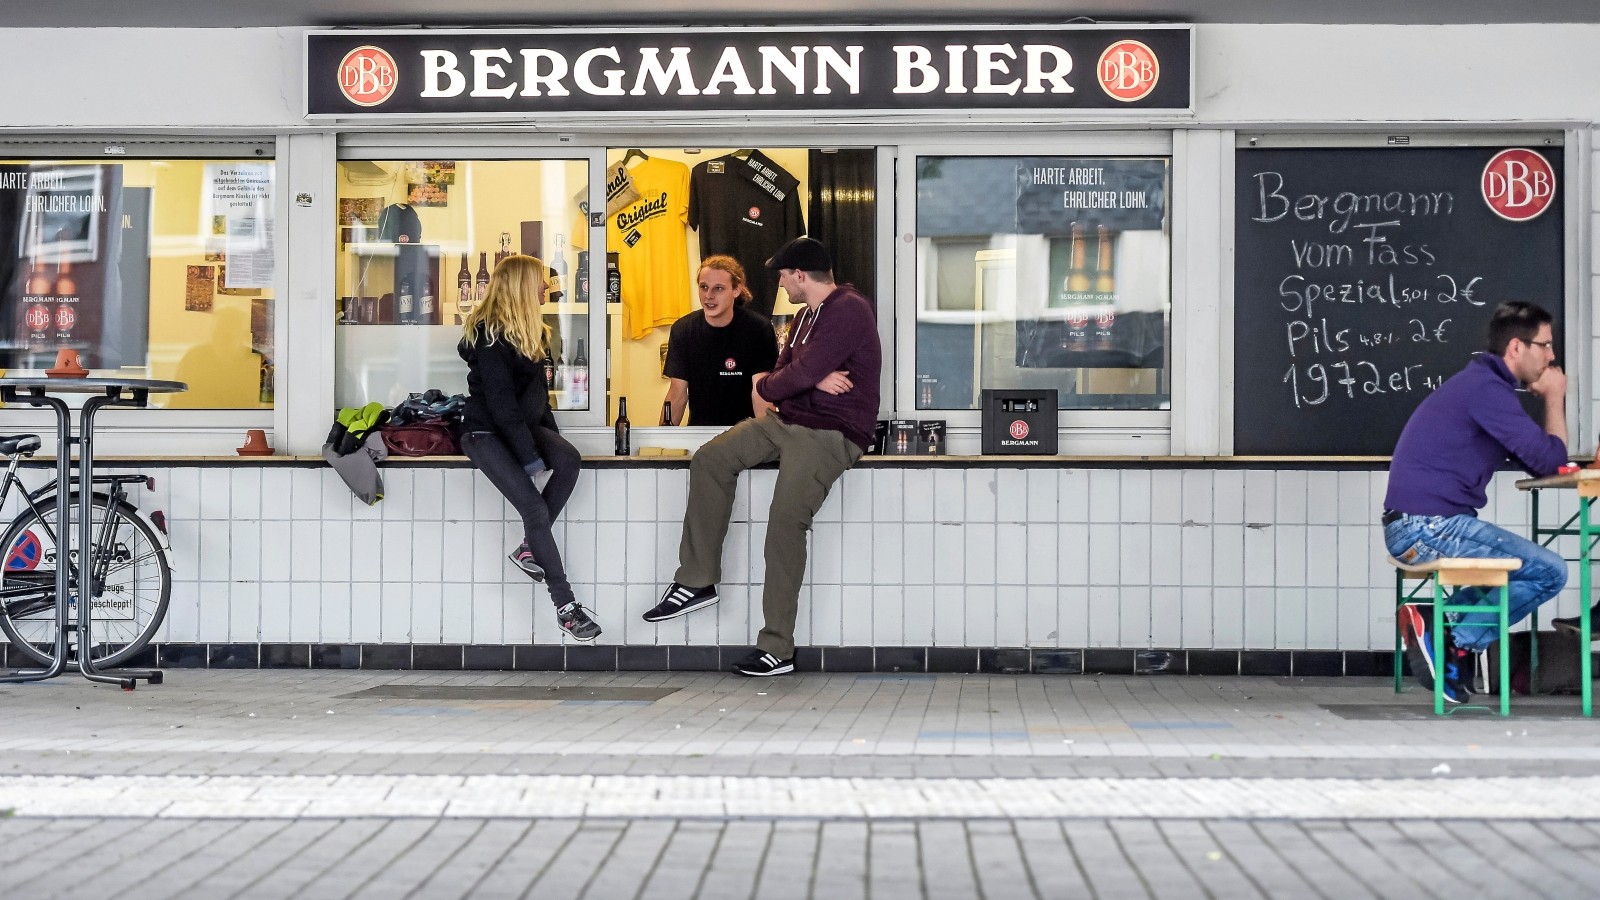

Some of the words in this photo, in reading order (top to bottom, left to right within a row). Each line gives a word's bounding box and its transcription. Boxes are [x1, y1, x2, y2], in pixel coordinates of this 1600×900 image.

[343, 55, 394, 95] DBB
[419, 45, 865, 100] BERGMANN
[892, 42, 1075, 97] BIER
[1103, 51, 1155, 90] DBB
[31, 172, 66, 190] ARBEIT.
[1033, 167, 1066, 185] HARTE
[1068, 167, 1106, 186] ARBEIT.
[1488, 160, 1551, 207] DBB
[25, 195, 77, 213] EHRLICHER
[79, 195, 107, 213] LOHN.
[616, 191, 668, 230] Original
[1063, 191, 1117, 209] EHRLICHER
[1119, 191, 1148, 209] LOHN.
[1252, 171, 1454, 234] Bergmann
[1291, 239, 1353, 268] vom
[1354, 220, 1437, 266] Fass
[1279, 273, 1401, 319] Spezial
[1287, 317, 1351, 357] Pils
[1011, 423, 1028, 436] DBB
